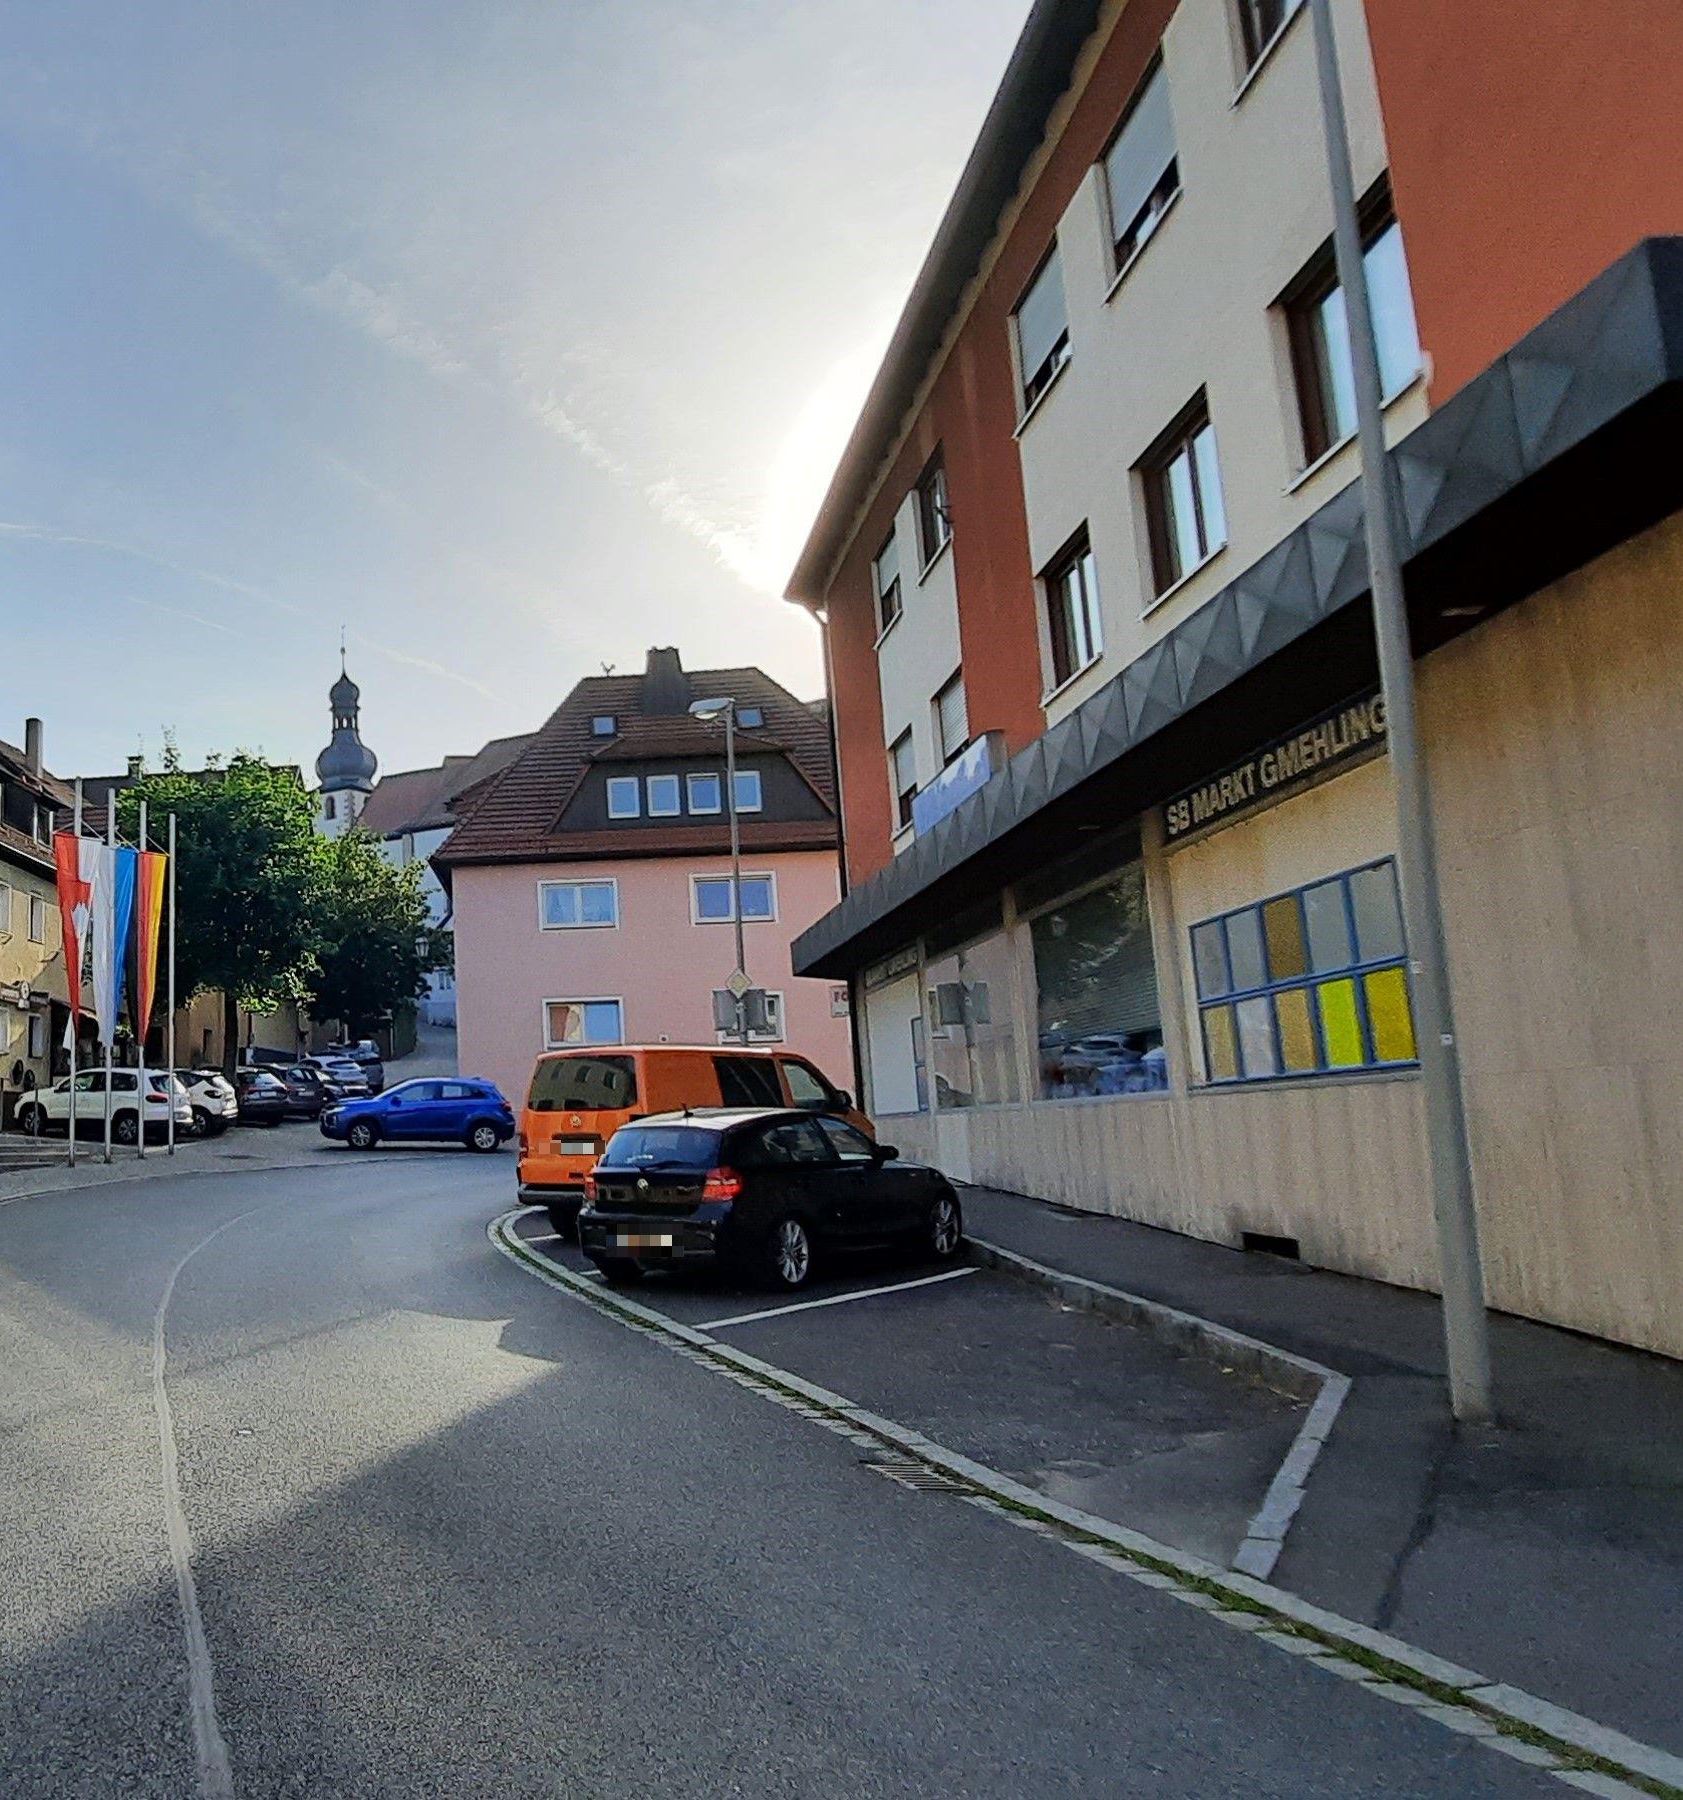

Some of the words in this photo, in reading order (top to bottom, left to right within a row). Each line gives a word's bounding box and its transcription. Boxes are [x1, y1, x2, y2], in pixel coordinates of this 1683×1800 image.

[1167, 799, 1190, 835] SB
[1191, 763, 1255, 824] MARKT
[1260, 694, 1388, 788] GMEHLING
